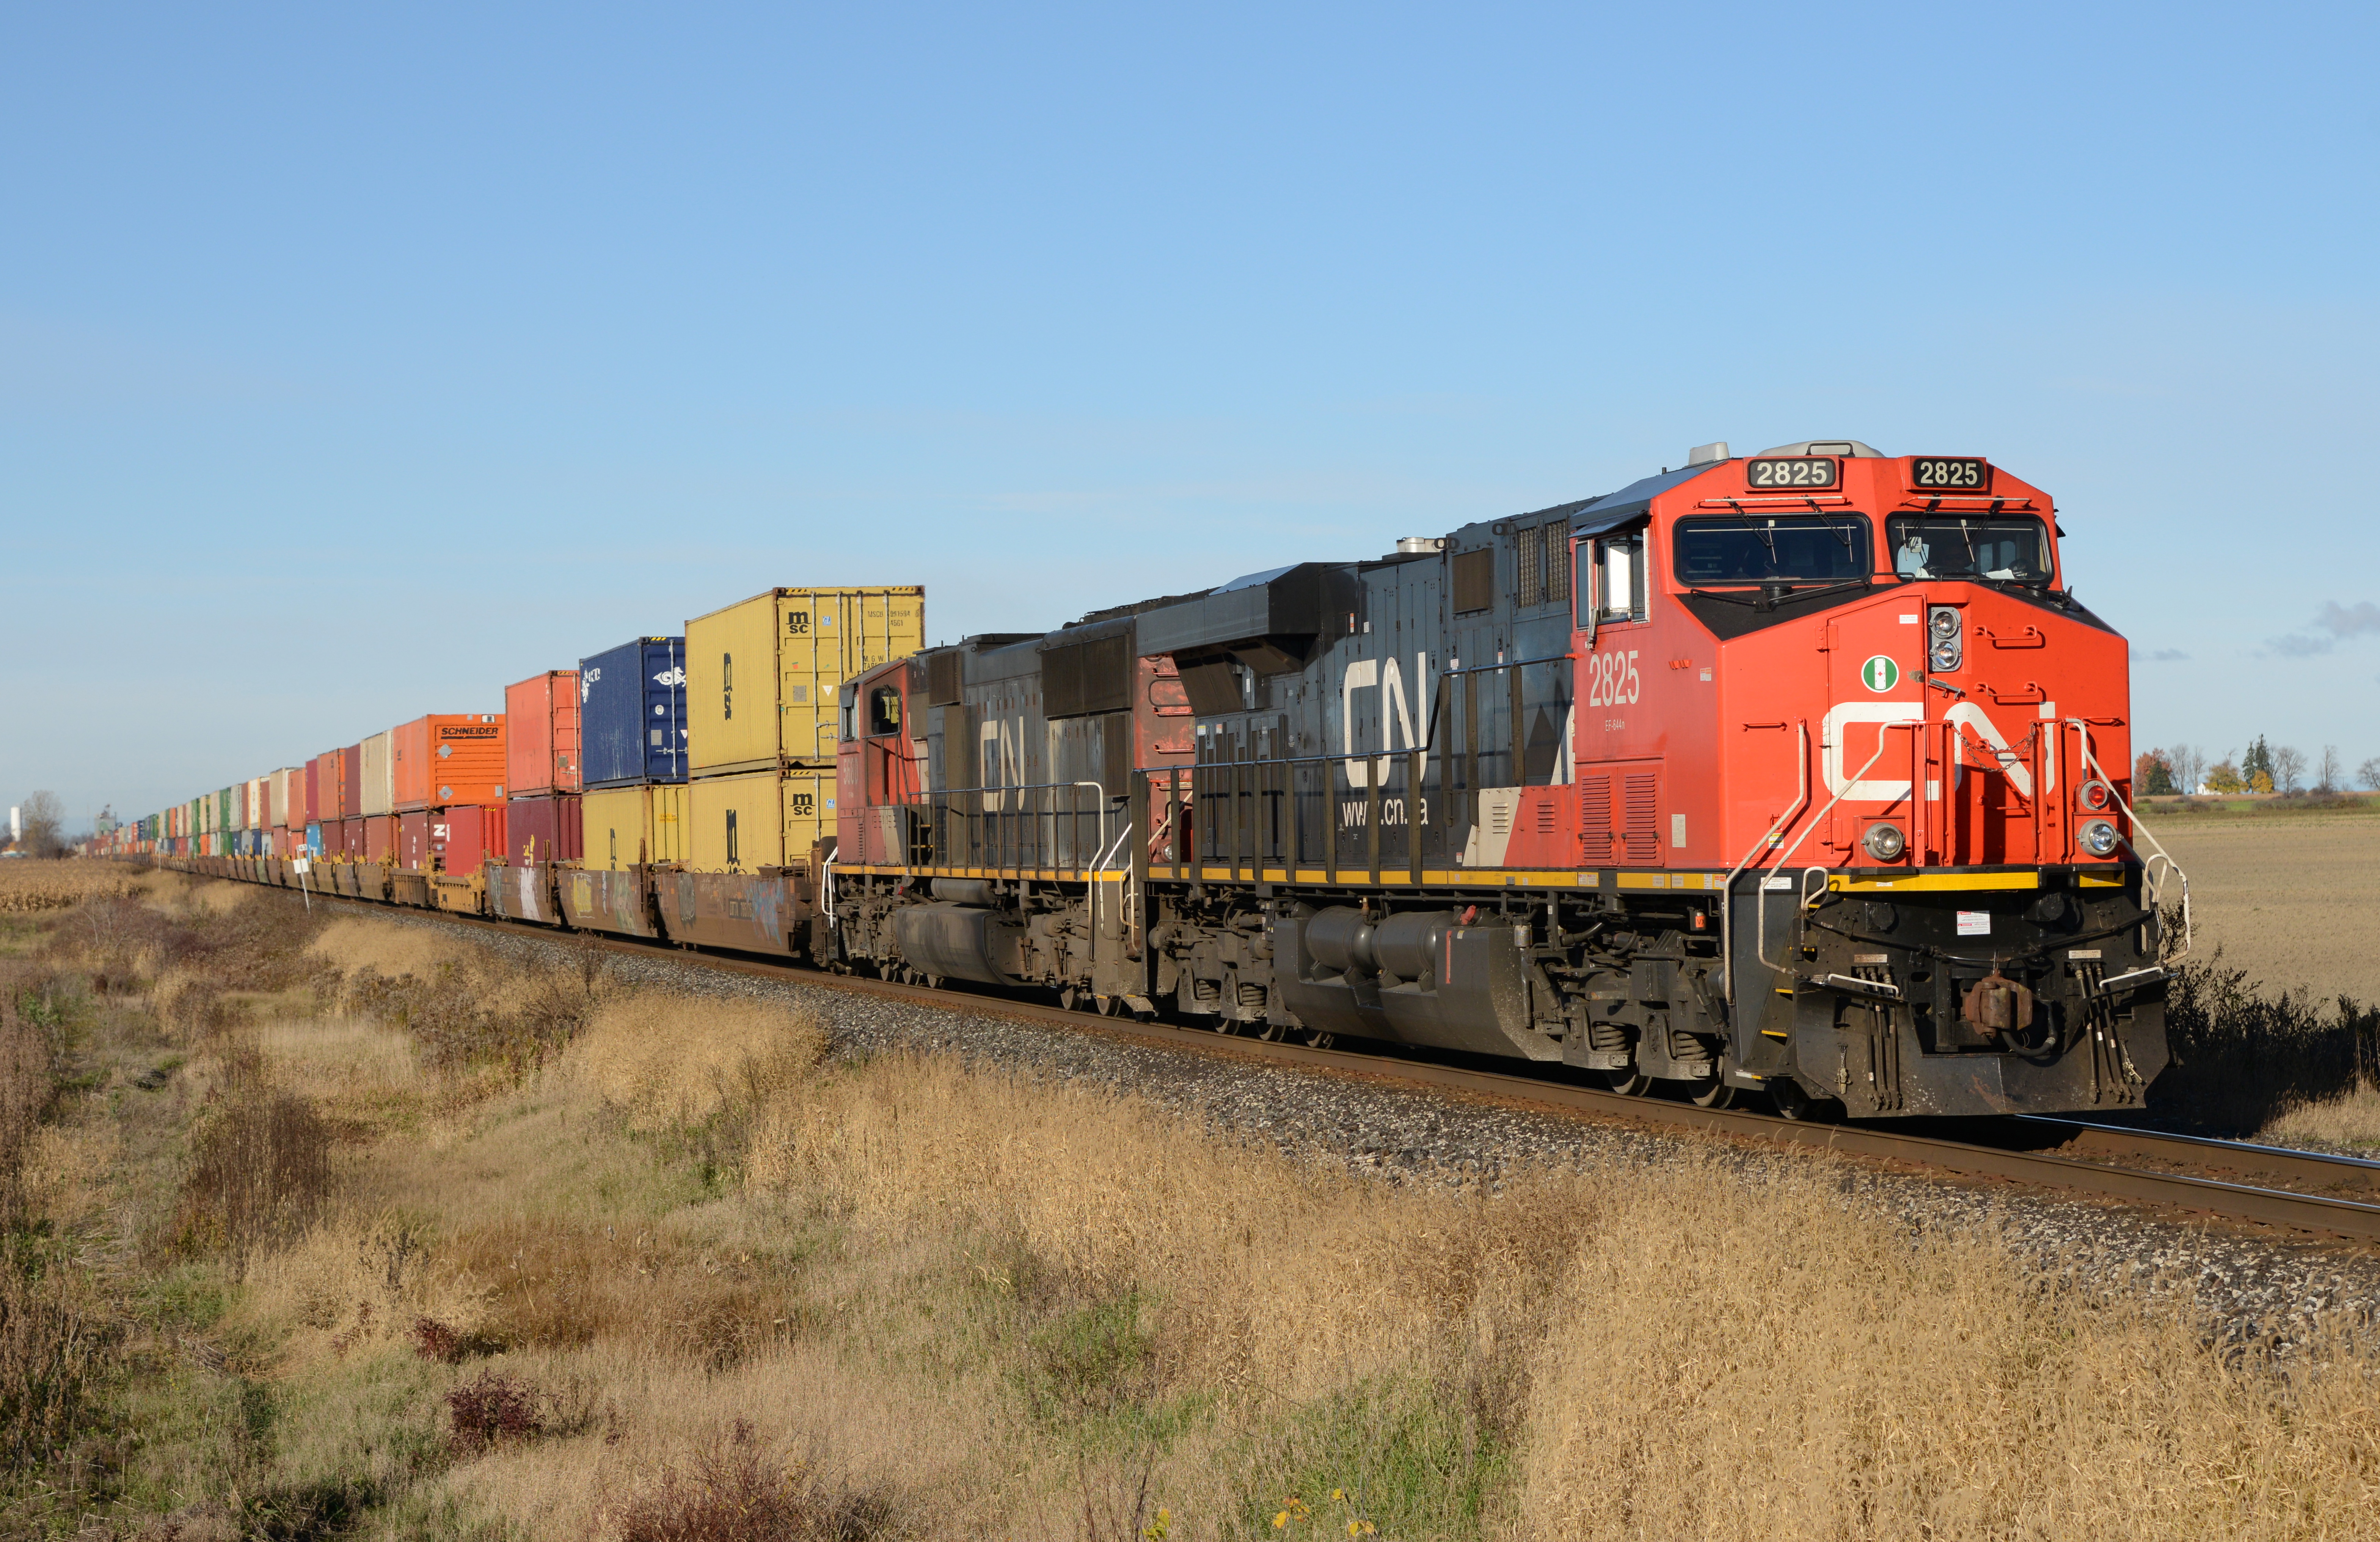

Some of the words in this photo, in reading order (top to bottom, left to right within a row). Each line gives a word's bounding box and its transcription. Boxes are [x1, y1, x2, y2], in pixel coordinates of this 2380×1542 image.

[1757, 462, 1827, 484] 2825
[1920, 462, 1978, 484] 2825
[1590, 650, 1639, 707] 2825
[1344, 652, 1426, 787] CN
[844, 758, 858, 785] 5680
[980, 716, 1024, 812] CN
[1822, 702, 2055, 800] CN
